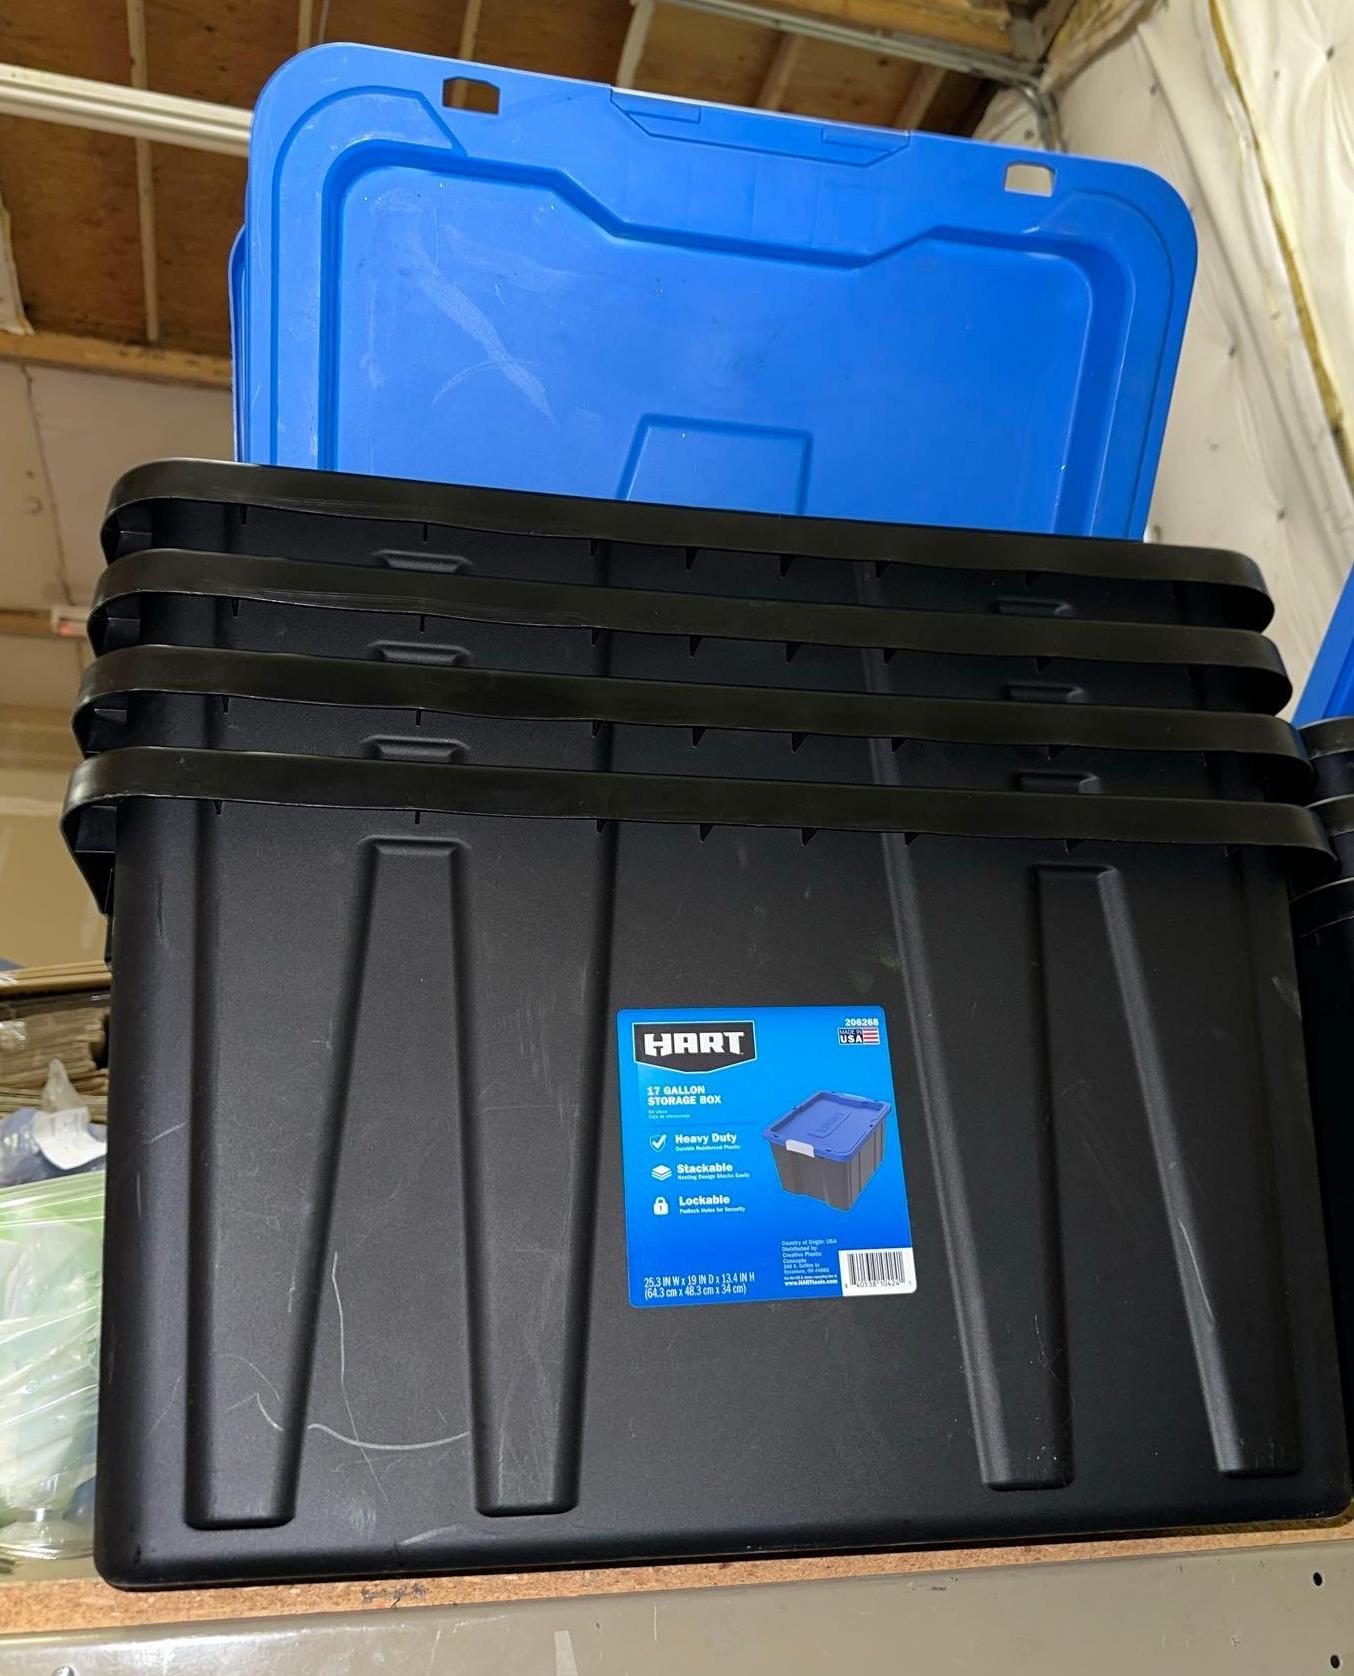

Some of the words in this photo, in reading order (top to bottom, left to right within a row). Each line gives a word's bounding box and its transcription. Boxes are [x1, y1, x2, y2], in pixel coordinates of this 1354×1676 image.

[643, 1031, 745, 1057] HART
[840, 1034, 863, 1043] USA
[647, 1086, 660, 1095] 17
[663, 1085, 705, 1095] GALLON
[647, 1096, 697, 1106] STORAGE
[699, 1095, 722, 1104] BOX
[675, 1134, 709, 1145] Heavy
[711, 1133, 737, 1144] Duty
[677, 1163, 733, 1174] Stackable
[679, 1194, 731, 1206] Lockable
[643, 1277, 661, 1288] 25.3
[662, 1276, 671, 1287] IN
[671, 1275, 680, 1287] W
[681, 1277, 686, 1286] x
[687, 1274, 697, 1286] 19
[698, 1274, 707, 1285] IN
[708, 1273, 714, 1284] D
[715, 1276, 720, 1284] x
[721, 1272, 738, 1284] 13.4
[739, 1272, 748, 1283] IN
[749, 1271, 755, 1282] H
[644, 1287, 665, 1300] (64.3
[665, 1288, 678, 1298] cm
[678, 1288, 684, 1297] x
[684, 1285, 702, 1297] 48.3
[702, 1286, 715, 1296] cm
[715, 1286, 720, 1295] x
[721, 1283, 732, 1295] 34
[732, 1282, 747, 1296] cm)
